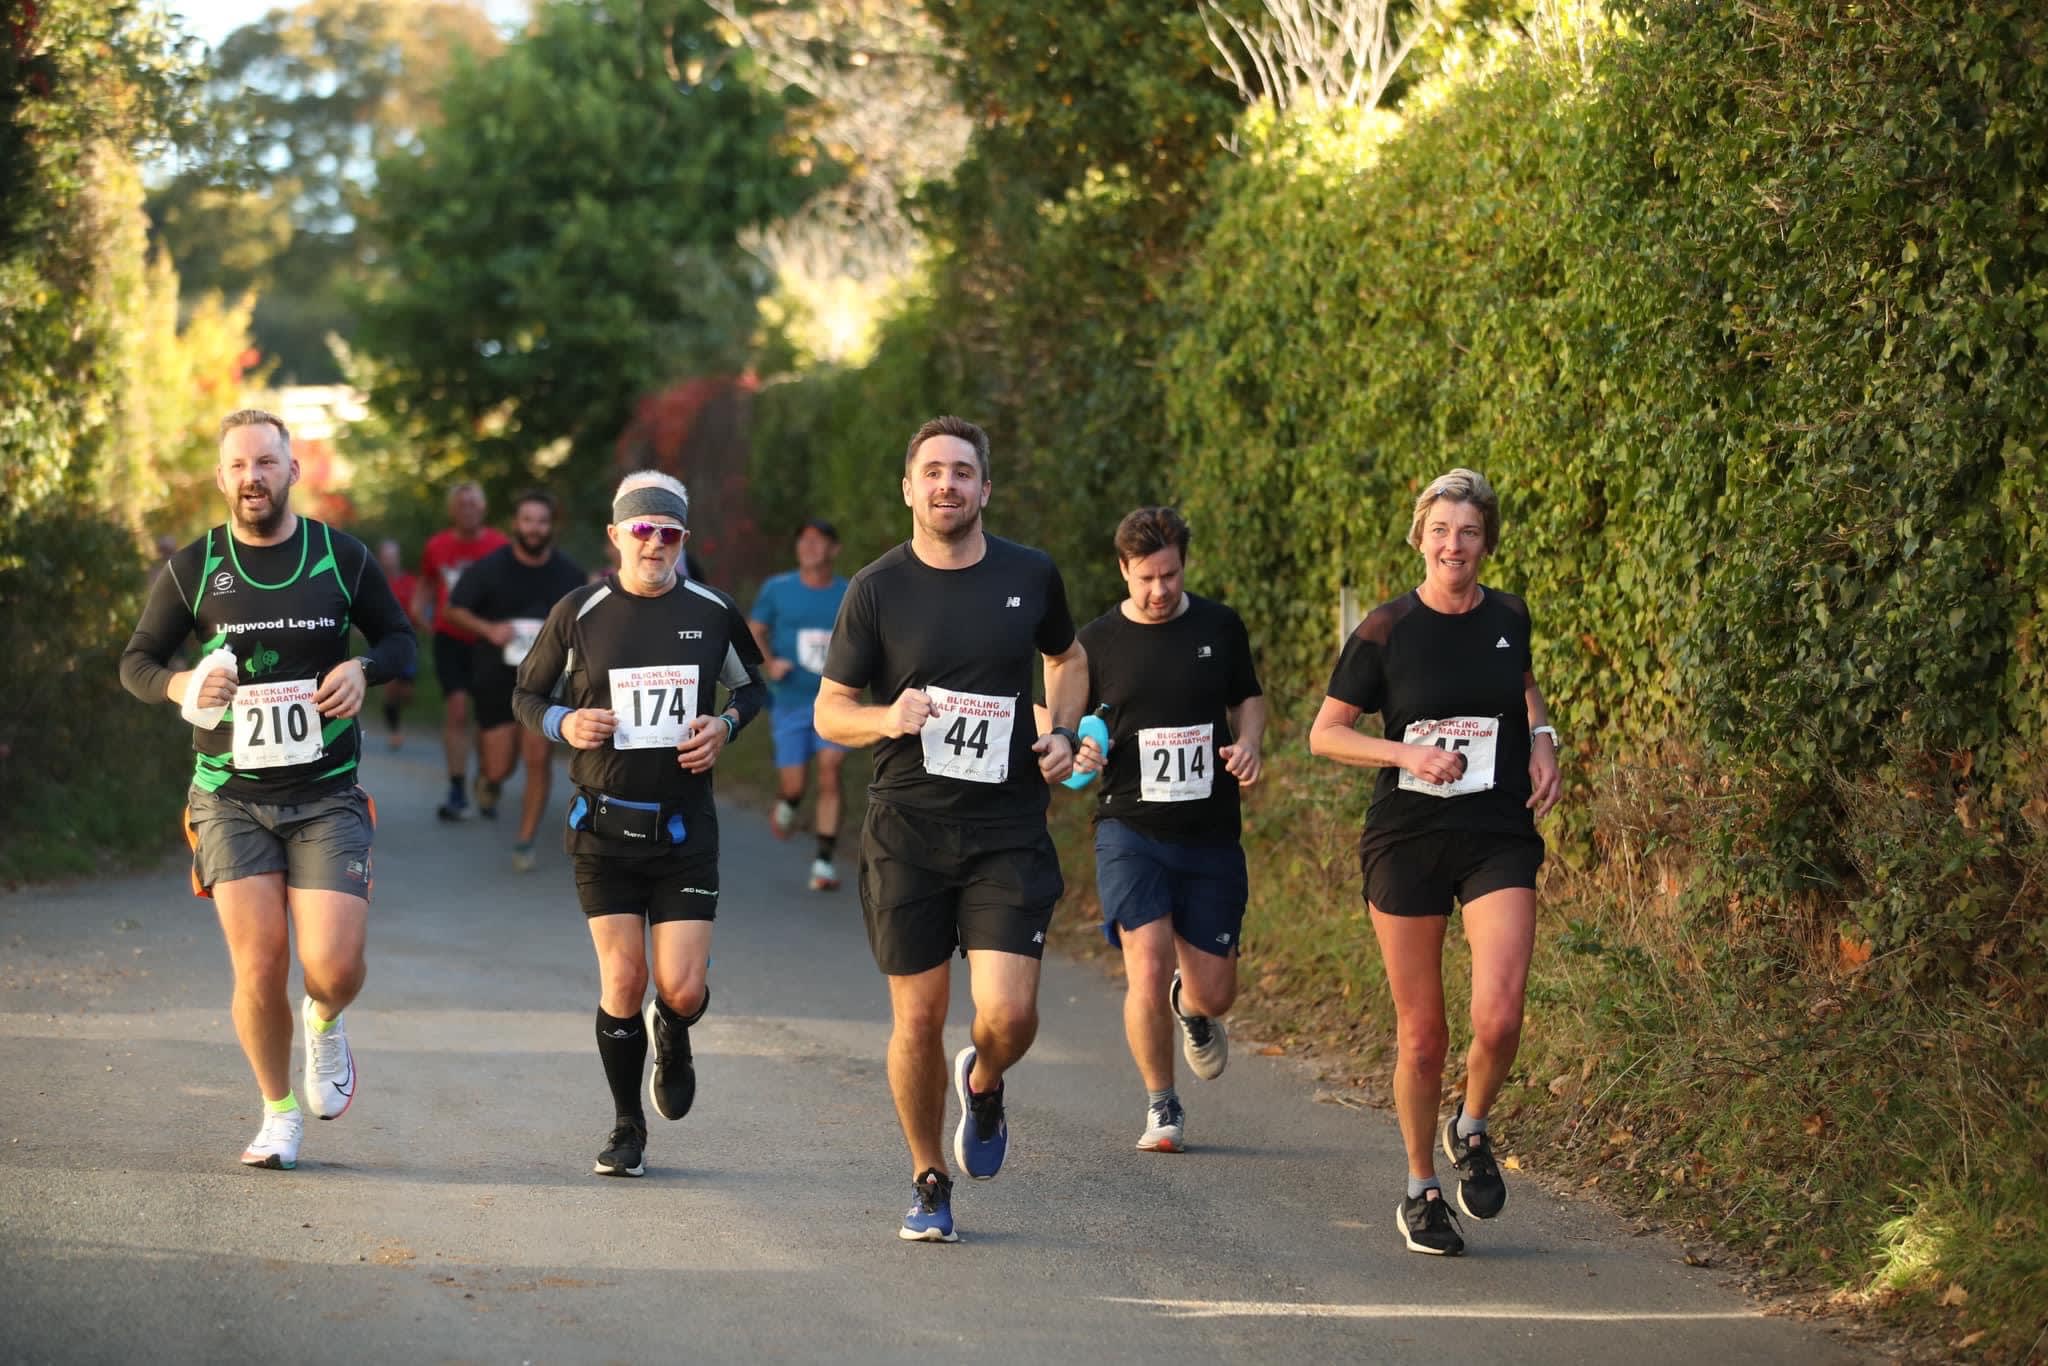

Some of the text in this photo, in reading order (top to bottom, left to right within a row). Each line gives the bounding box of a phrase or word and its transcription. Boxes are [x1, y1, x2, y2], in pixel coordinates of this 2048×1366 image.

[1006, 596, 1021, 608] NB
[216, 617, 335, 634] Lingwood Leg-its
[632, 670, 681, 680] BLICKLING
[618, 678, 695, 688] HALF MARATHON
[249, 686, 300, 697] BLICKLING
[263, 692, 315, 704] MARATHON
[946, 695, 1000, 709] BLICKLING
[633, 687, 686, 727] 174
[959, 706, 1011, 718] MARATHON
[246, 703, 309, 747] 210
[943, 716, 989, 759] 44
[1157, 729, 1201, 739] BLICKLING
[1439, 727, 1493, 737] MARATHON
[1145, 735, 1211, 747] HALF MARATHON
[1153, 745, 1205, 783] 214
